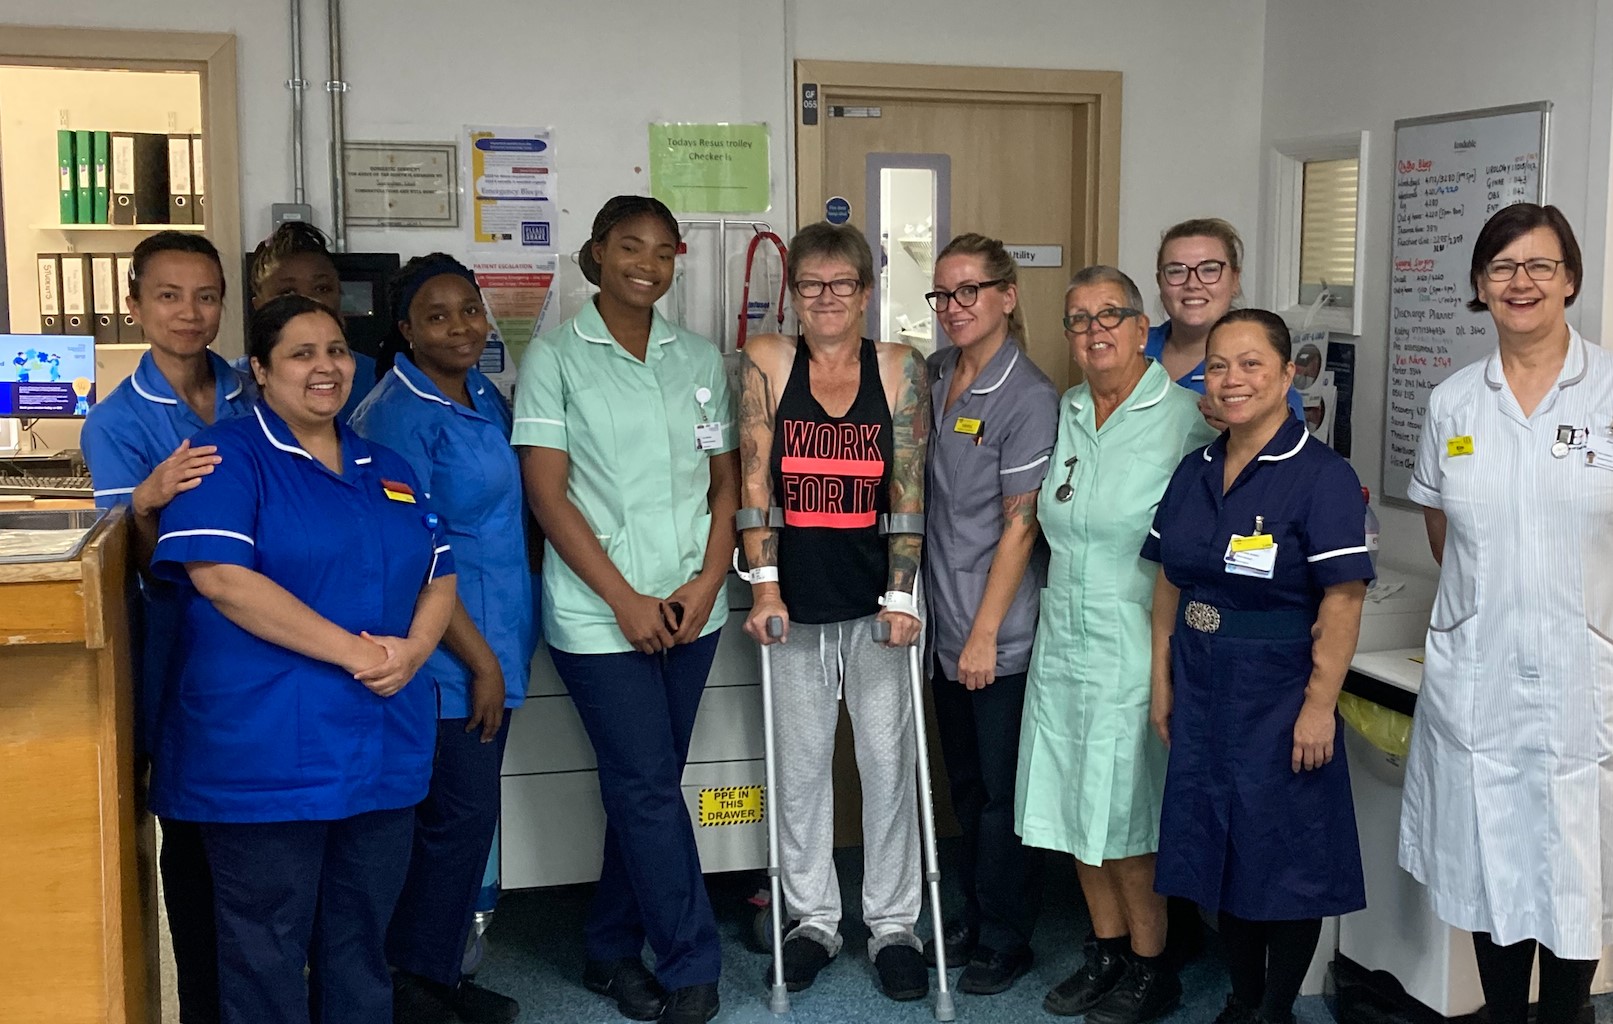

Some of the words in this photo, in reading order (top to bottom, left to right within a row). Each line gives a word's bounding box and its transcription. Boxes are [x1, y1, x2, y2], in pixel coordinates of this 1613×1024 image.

[805, 90, 816, 98] GF
[667, 138, 697, 147] Todays
[699, 138, 724, 147] Resus
[726, 138, 753, 149] trolley
[688, 152, 722, 161] Checker
[481, 187, 518, 196] Emergency
[43, 264, 53, 300] STUDENTS
[1394, 307, 1425, 322] Discharge
[1429, 308, 1455, 320] Planner
[784, 420, 882, 461] WORK
[782, 475, 844, 514] FOR
[853, 478, 881, 514] IT
[714, 791, 736, 800] PPE
[738, 790, 749, 799] IN
[720, 799, 744, 809] THIS
[708, 809, 755, 820] DRAWER
